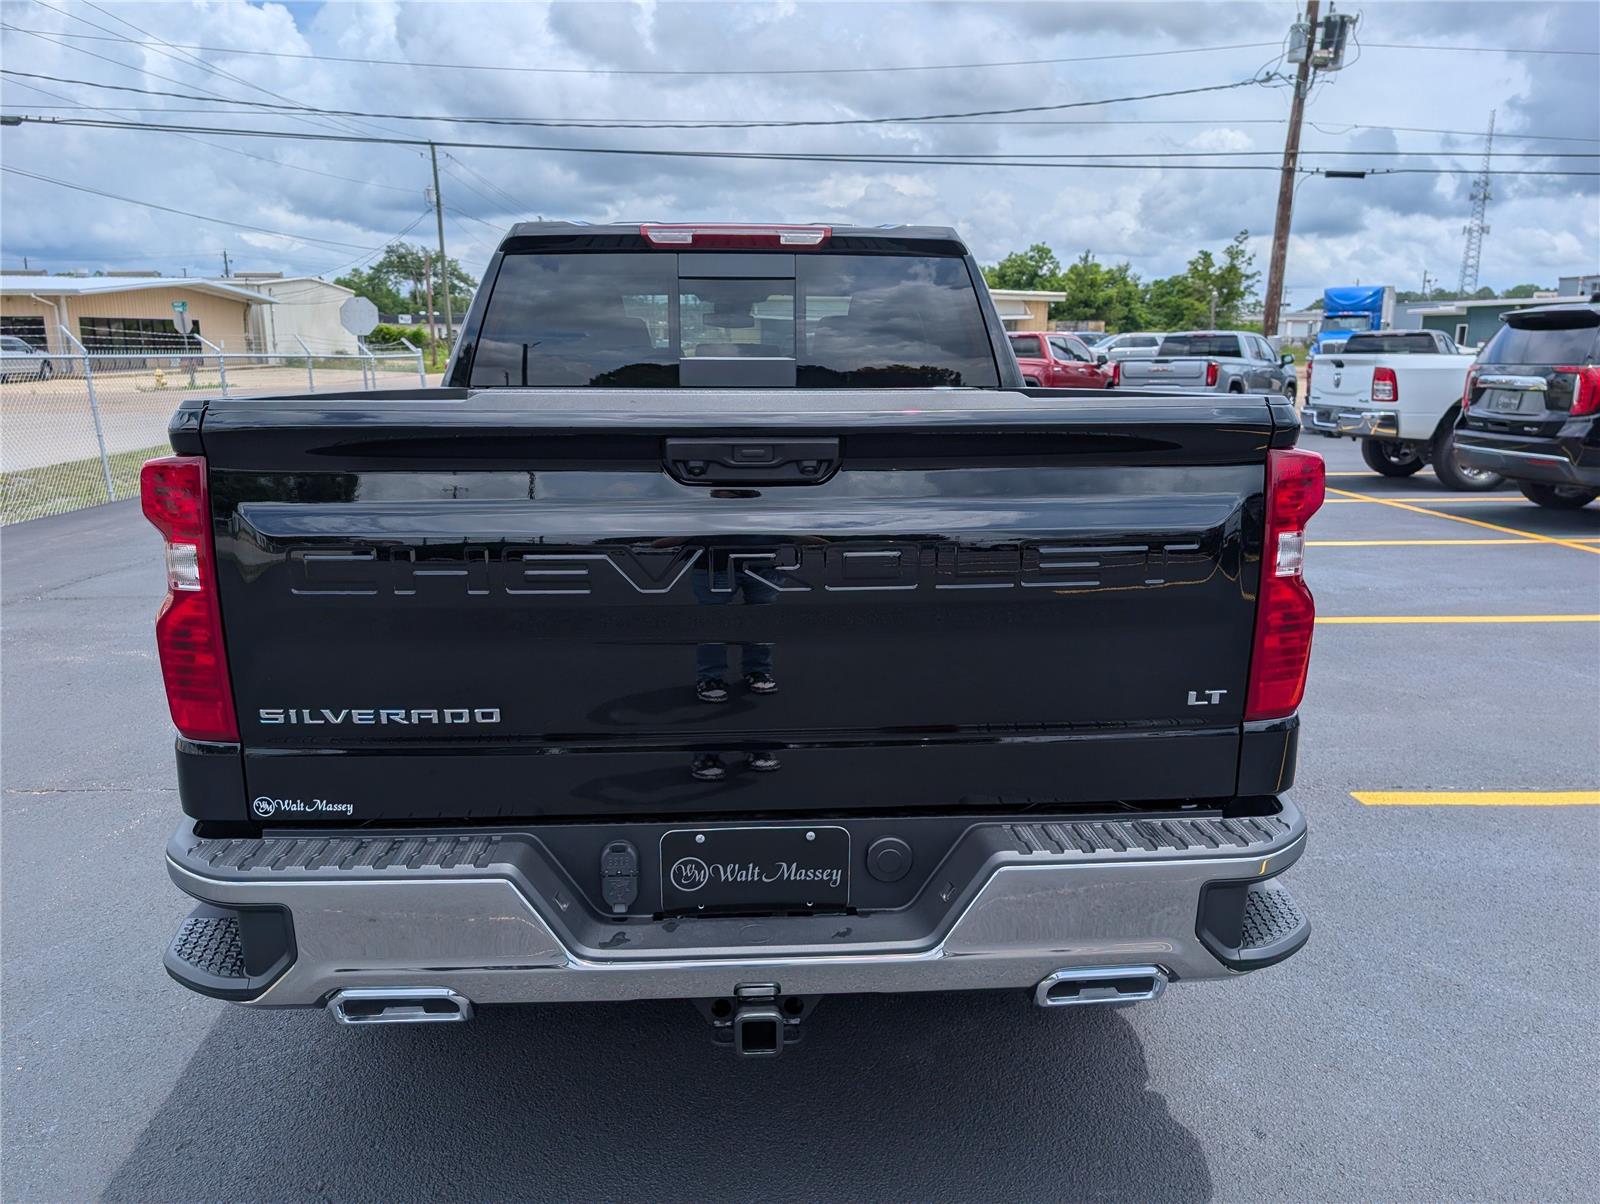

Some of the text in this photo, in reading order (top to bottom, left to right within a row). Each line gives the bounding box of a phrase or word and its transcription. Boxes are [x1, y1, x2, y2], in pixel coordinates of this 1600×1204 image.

[286, 536, 1202, 595] CHEVROLET
[1187, 690, 1227, 705] LT
[258, 708, 501, 725] SILVERADO
[274, 799, 305, 812] Walt
[305, 799, 354, 815] Massey
[709, 862, 761, 883] Walt
[762, 861, 842, 888] Massey
